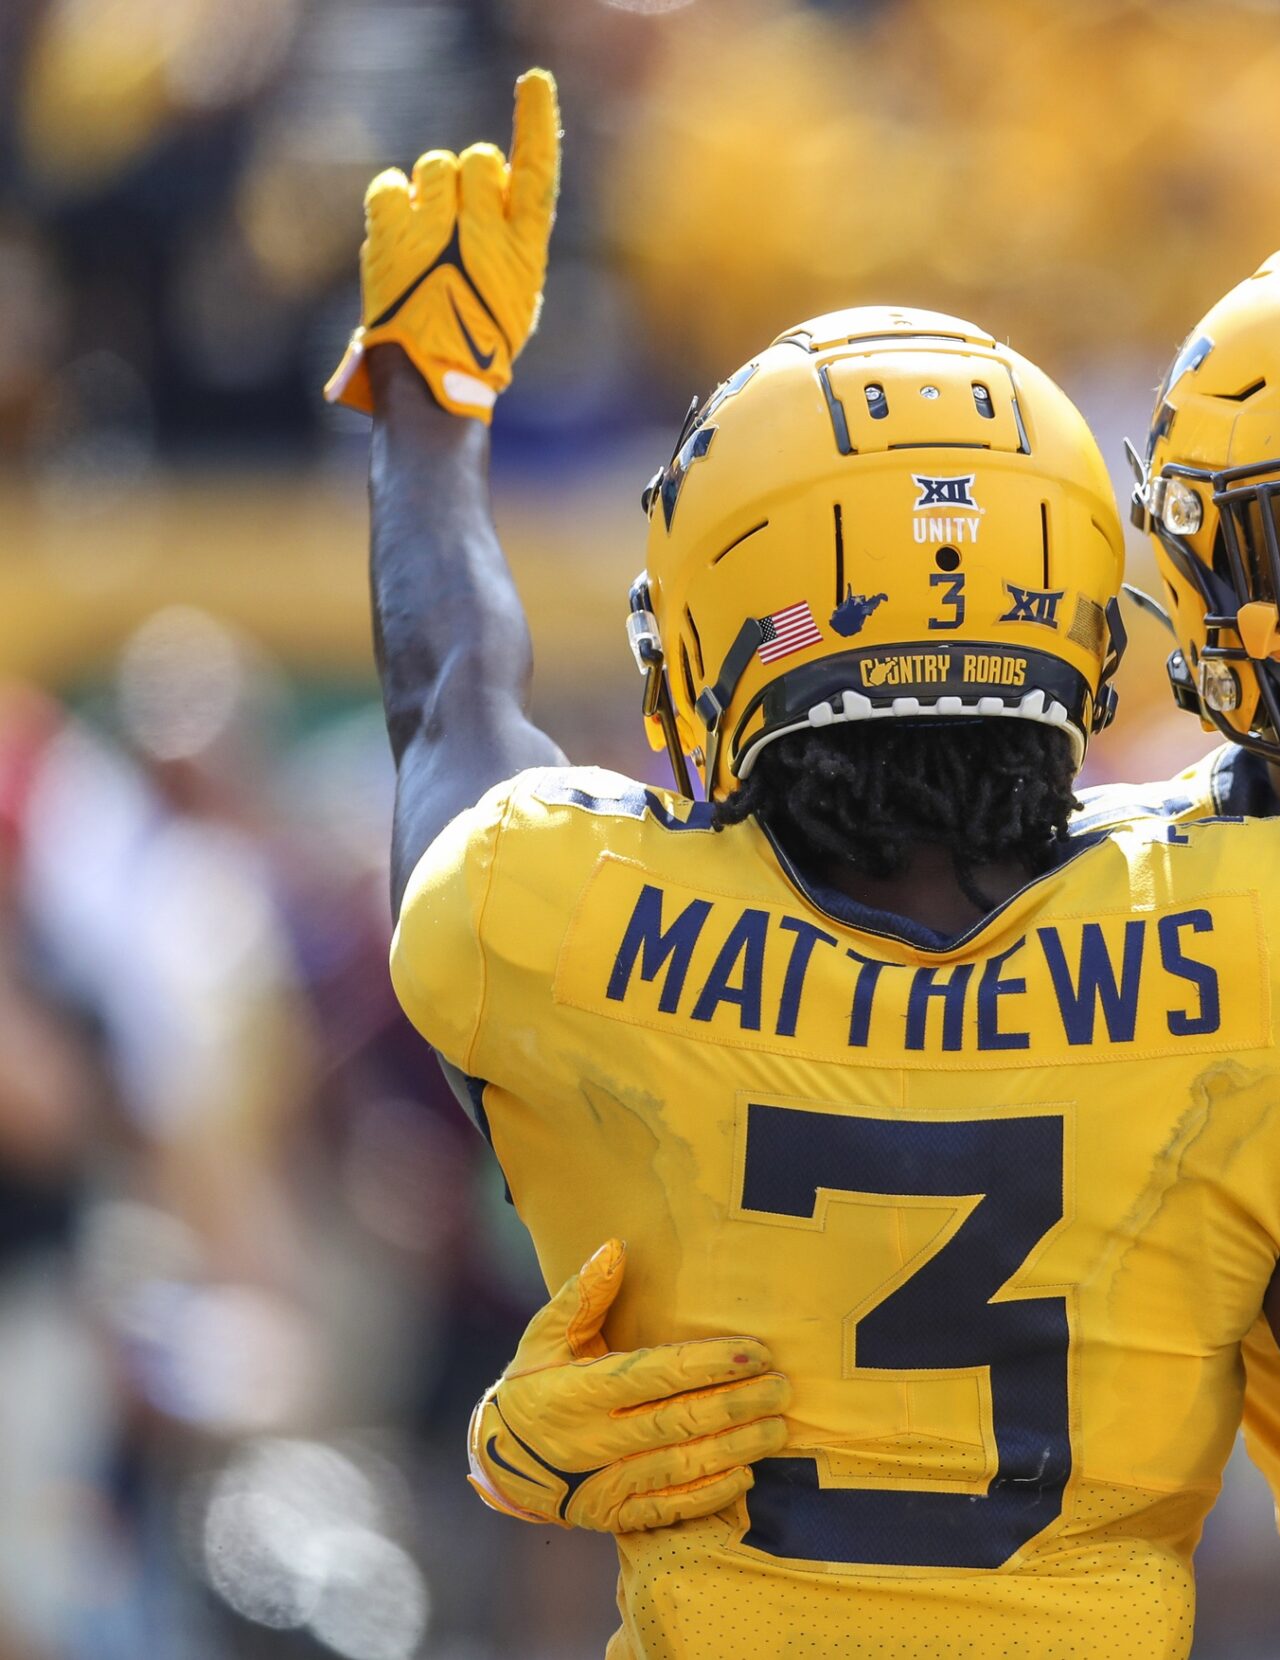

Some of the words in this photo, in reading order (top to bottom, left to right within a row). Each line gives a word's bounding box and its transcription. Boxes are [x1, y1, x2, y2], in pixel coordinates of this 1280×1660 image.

[912, 517, 980, 544] UNITY
[927, 573, 966, 630] 3
[859, 654, 951, 688] CUNTRY
[962, 654, 1028, 687] ROADS
[605, 884, 1221, 1054] MATTHEWS
[740, 1103, 1073, 1570] 3
